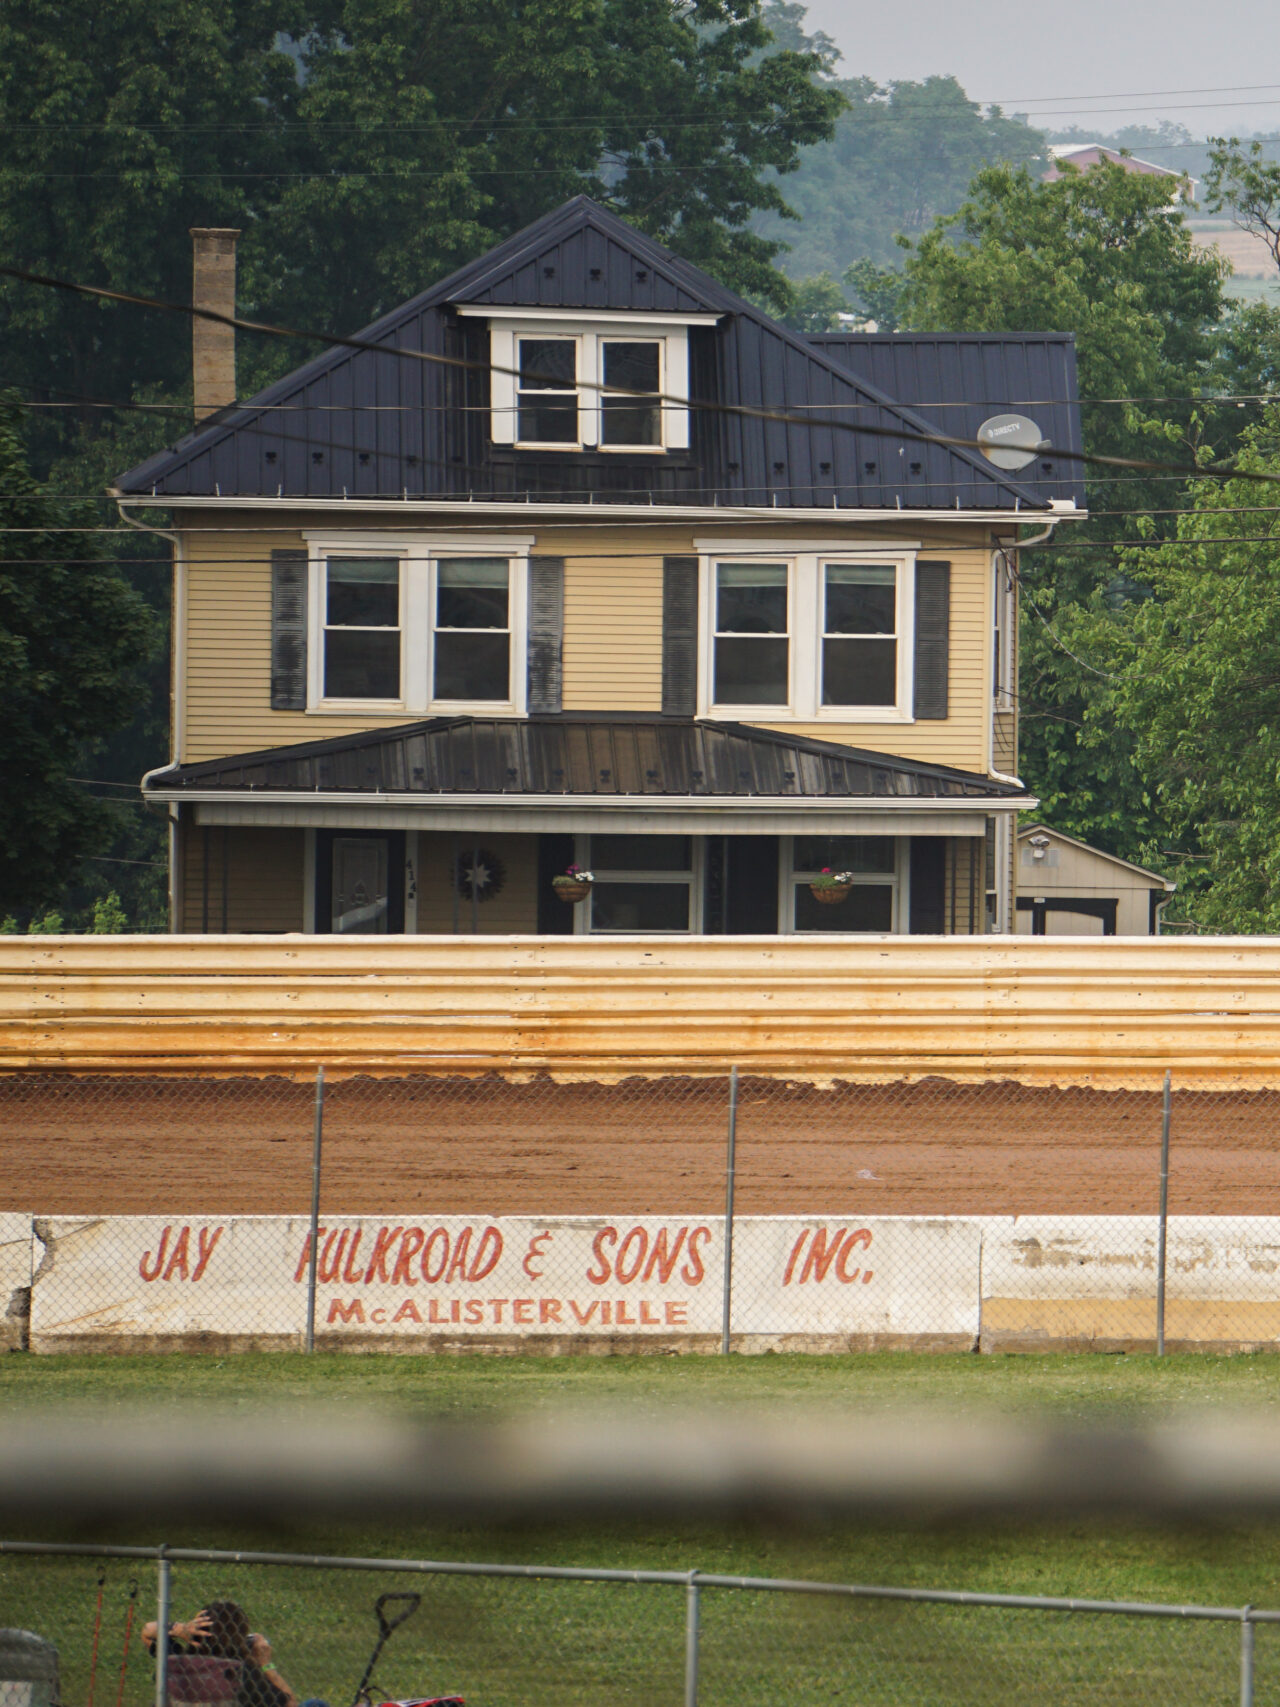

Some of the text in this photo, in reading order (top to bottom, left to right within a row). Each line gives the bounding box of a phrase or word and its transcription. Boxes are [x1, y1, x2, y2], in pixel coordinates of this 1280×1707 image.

[139, 1225, 224, 1282] JAY
[522, 1230, 554, 1281] &
[586, 1225, 712, 1286] SONS
[782, 1227, 873, 1287] INC.
